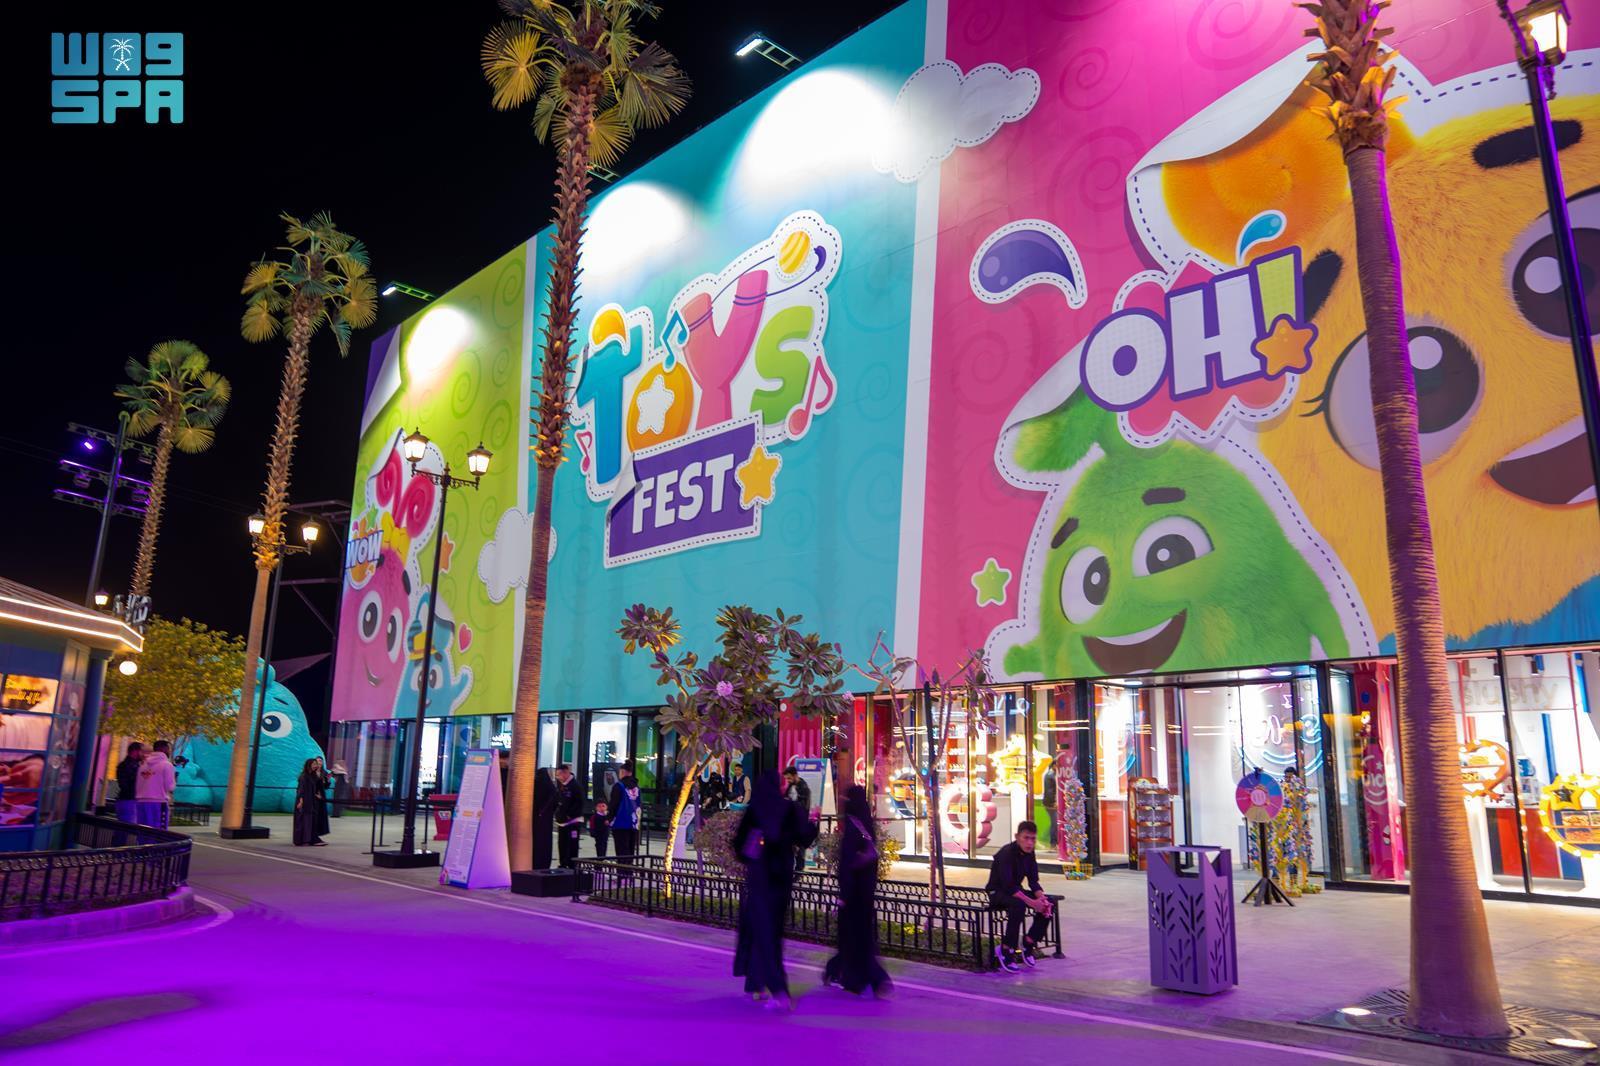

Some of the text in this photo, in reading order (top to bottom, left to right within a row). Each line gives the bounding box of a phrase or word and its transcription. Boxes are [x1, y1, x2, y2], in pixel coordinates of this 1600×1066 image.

[573, 270, 813, 484] TOYS
[1080, 246, 1318, 412] OH!
[345, 530, 384, 569] WOW
[632, 453, 734, 533] FEST
